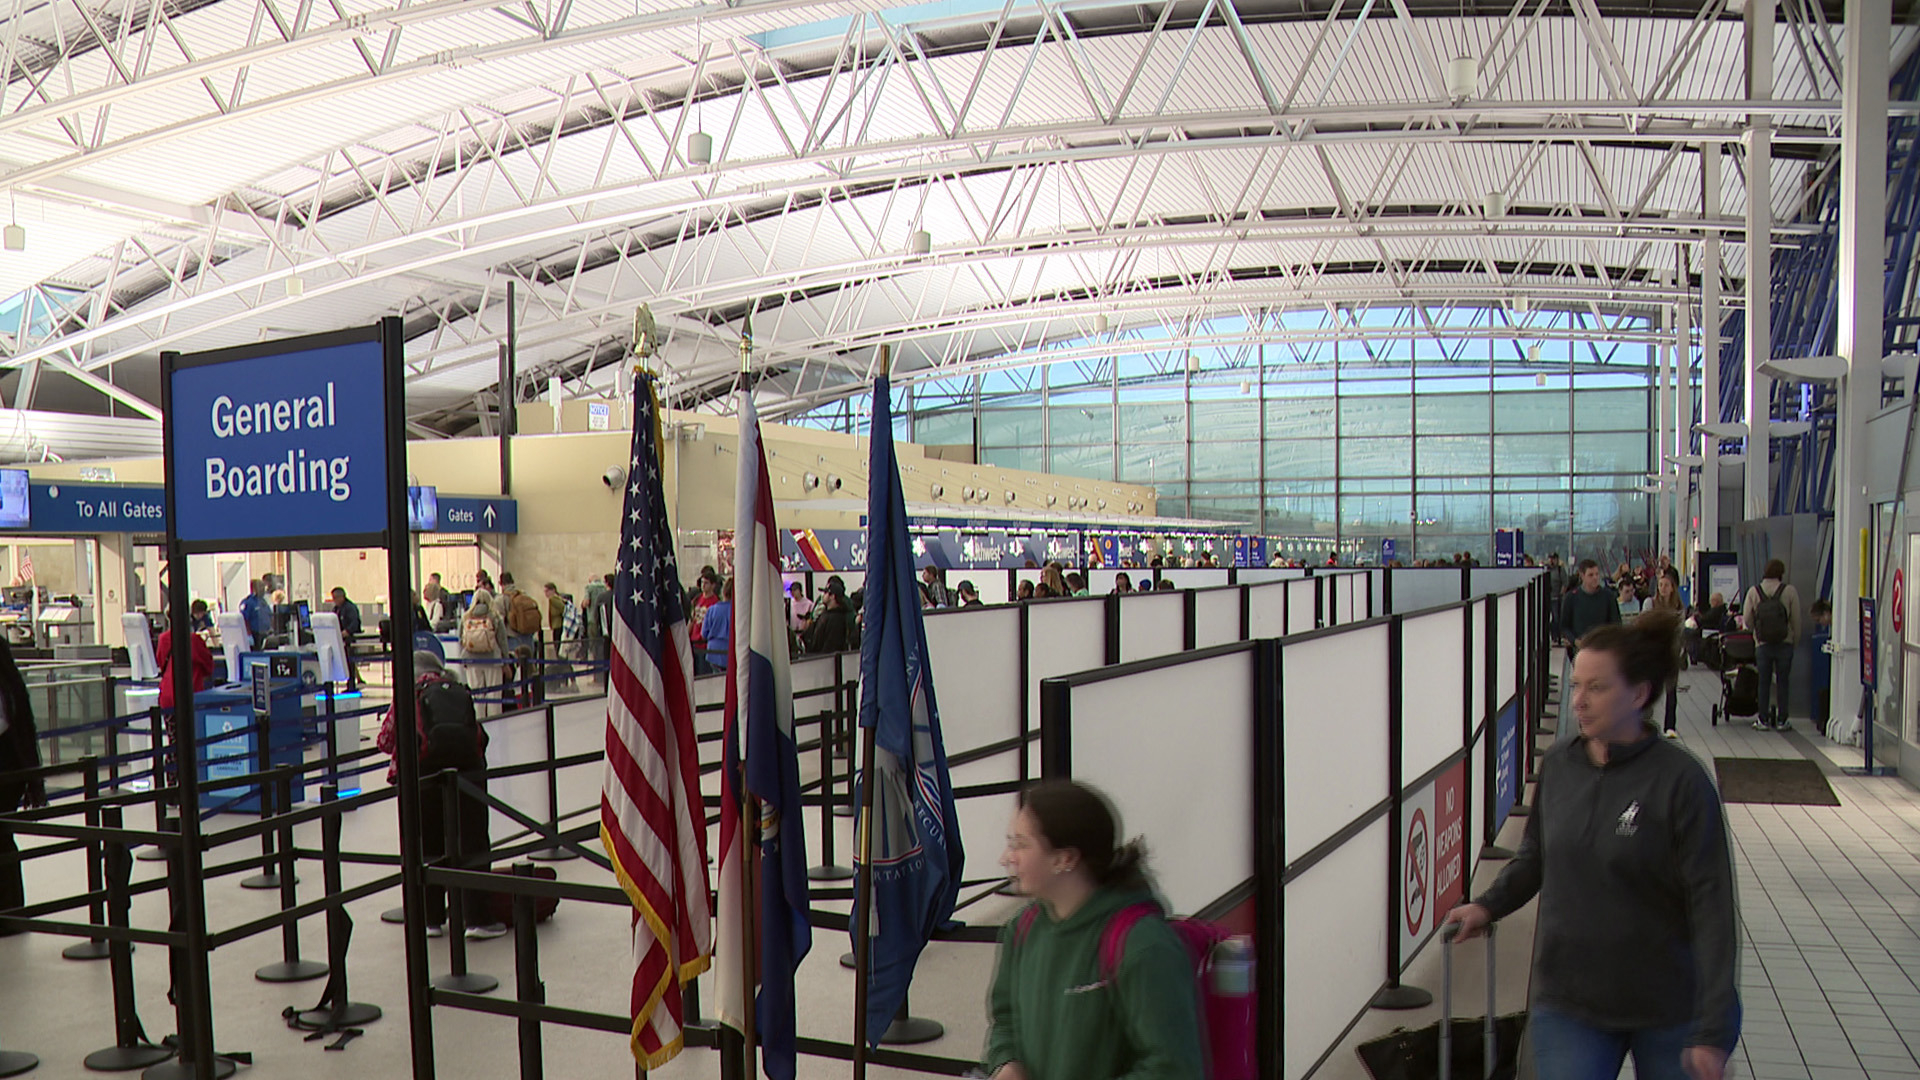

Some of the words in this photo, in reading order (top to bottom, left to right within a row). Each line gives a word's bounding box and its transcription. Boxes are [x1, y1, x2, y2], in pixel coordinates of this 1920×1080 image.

[211, 381, 336, 438] General
[206, 449, 351, 501] Boarding
[76, 500, 94, 518] To
[98, 500, 117, 518] All
[122, 501, 163, 518] Gates
[448, 508, 474, 522] Gates
[1895, 579, 1902, 622] 2
[1446, 786, 1454, 815] NO
[1436, 816, 1462, 861] WEAPONS
[1436, 853, 1460, 898] ALLOWED
